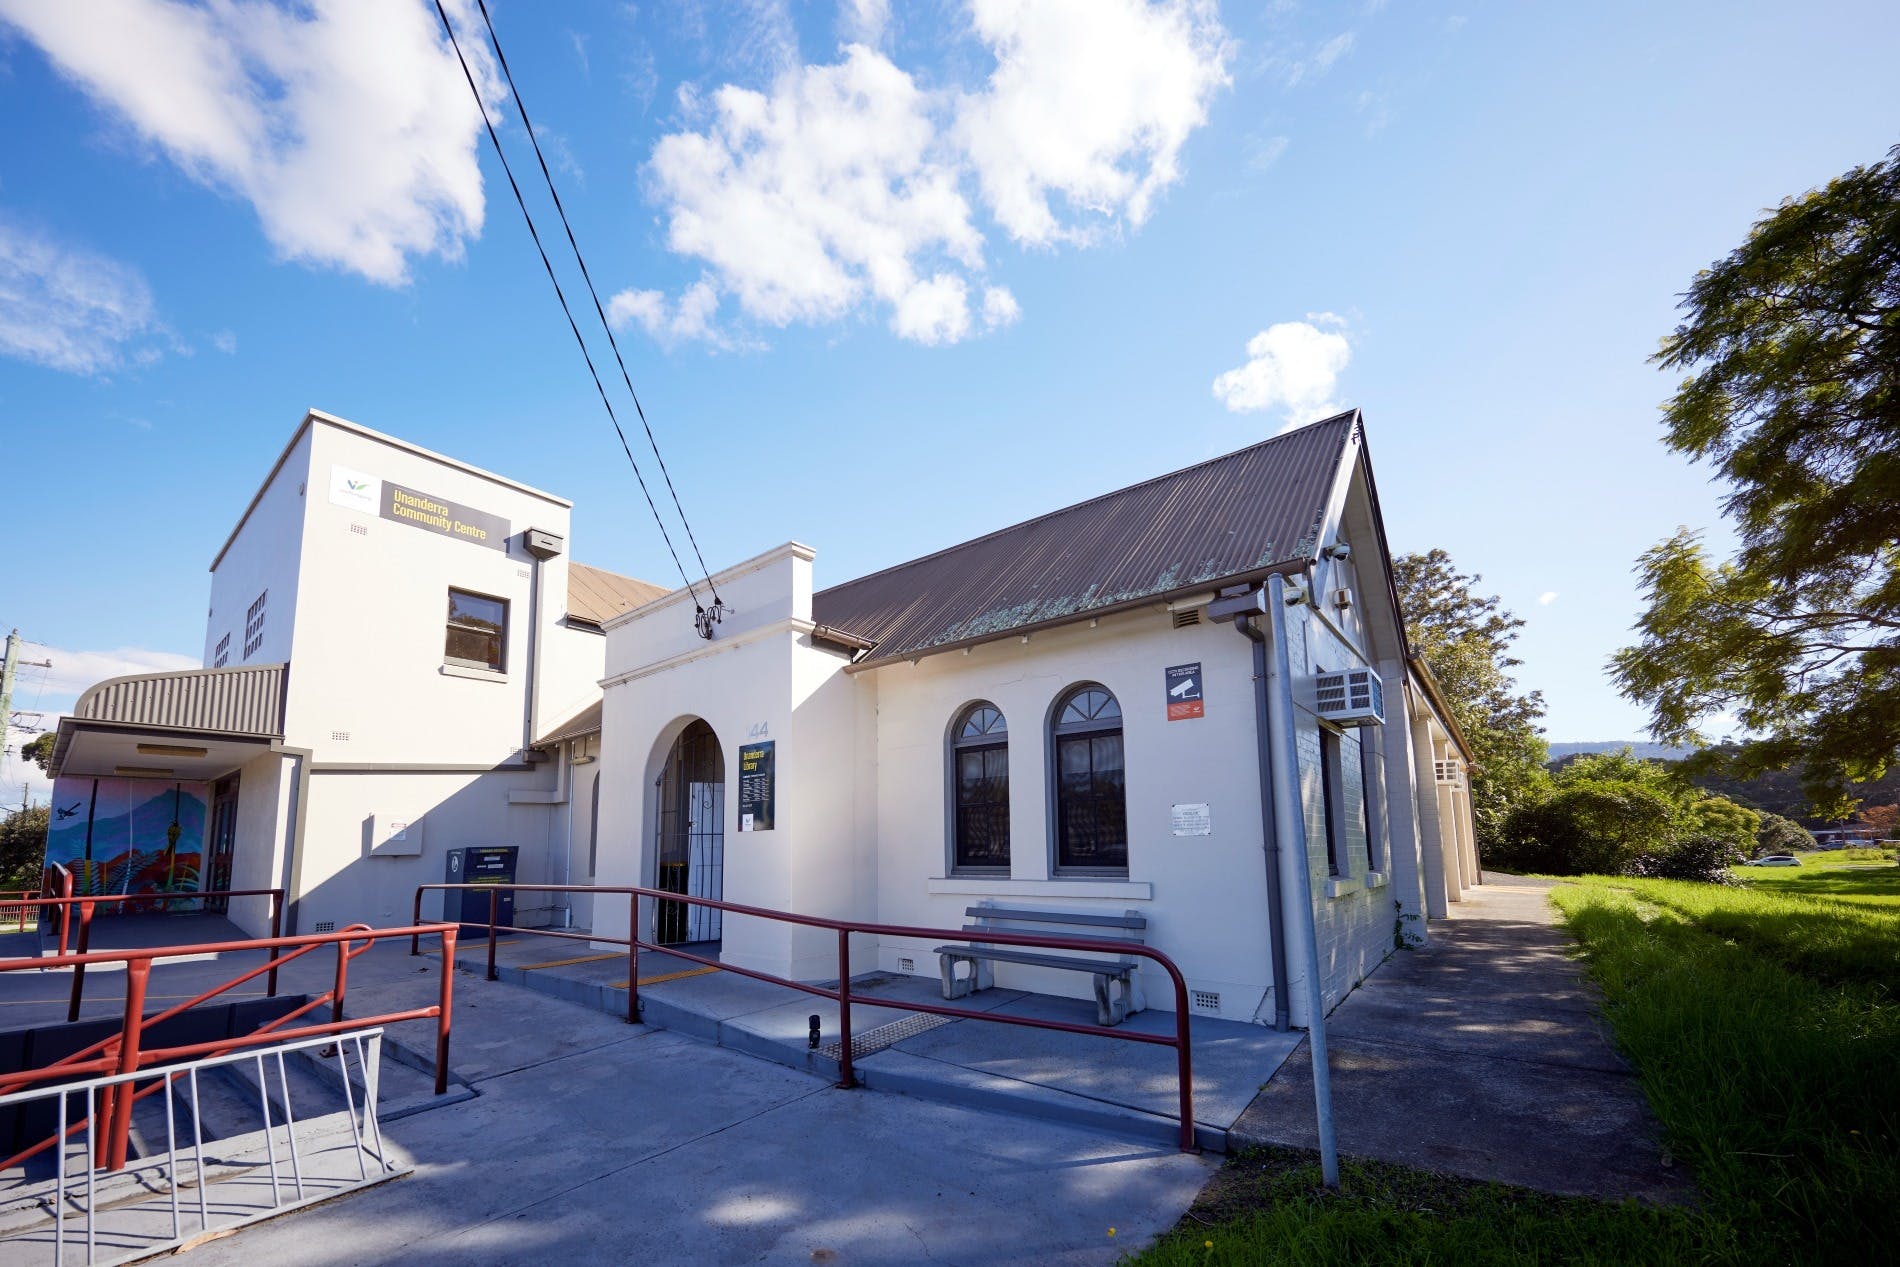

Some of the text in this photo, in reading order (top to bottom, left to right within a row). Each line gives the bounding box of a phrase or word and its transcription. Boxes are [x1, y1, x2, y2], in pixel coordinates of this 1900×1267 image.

[394, 490, 448, 516] Unanderra
[393, 503, 486, 539] Community Centre
